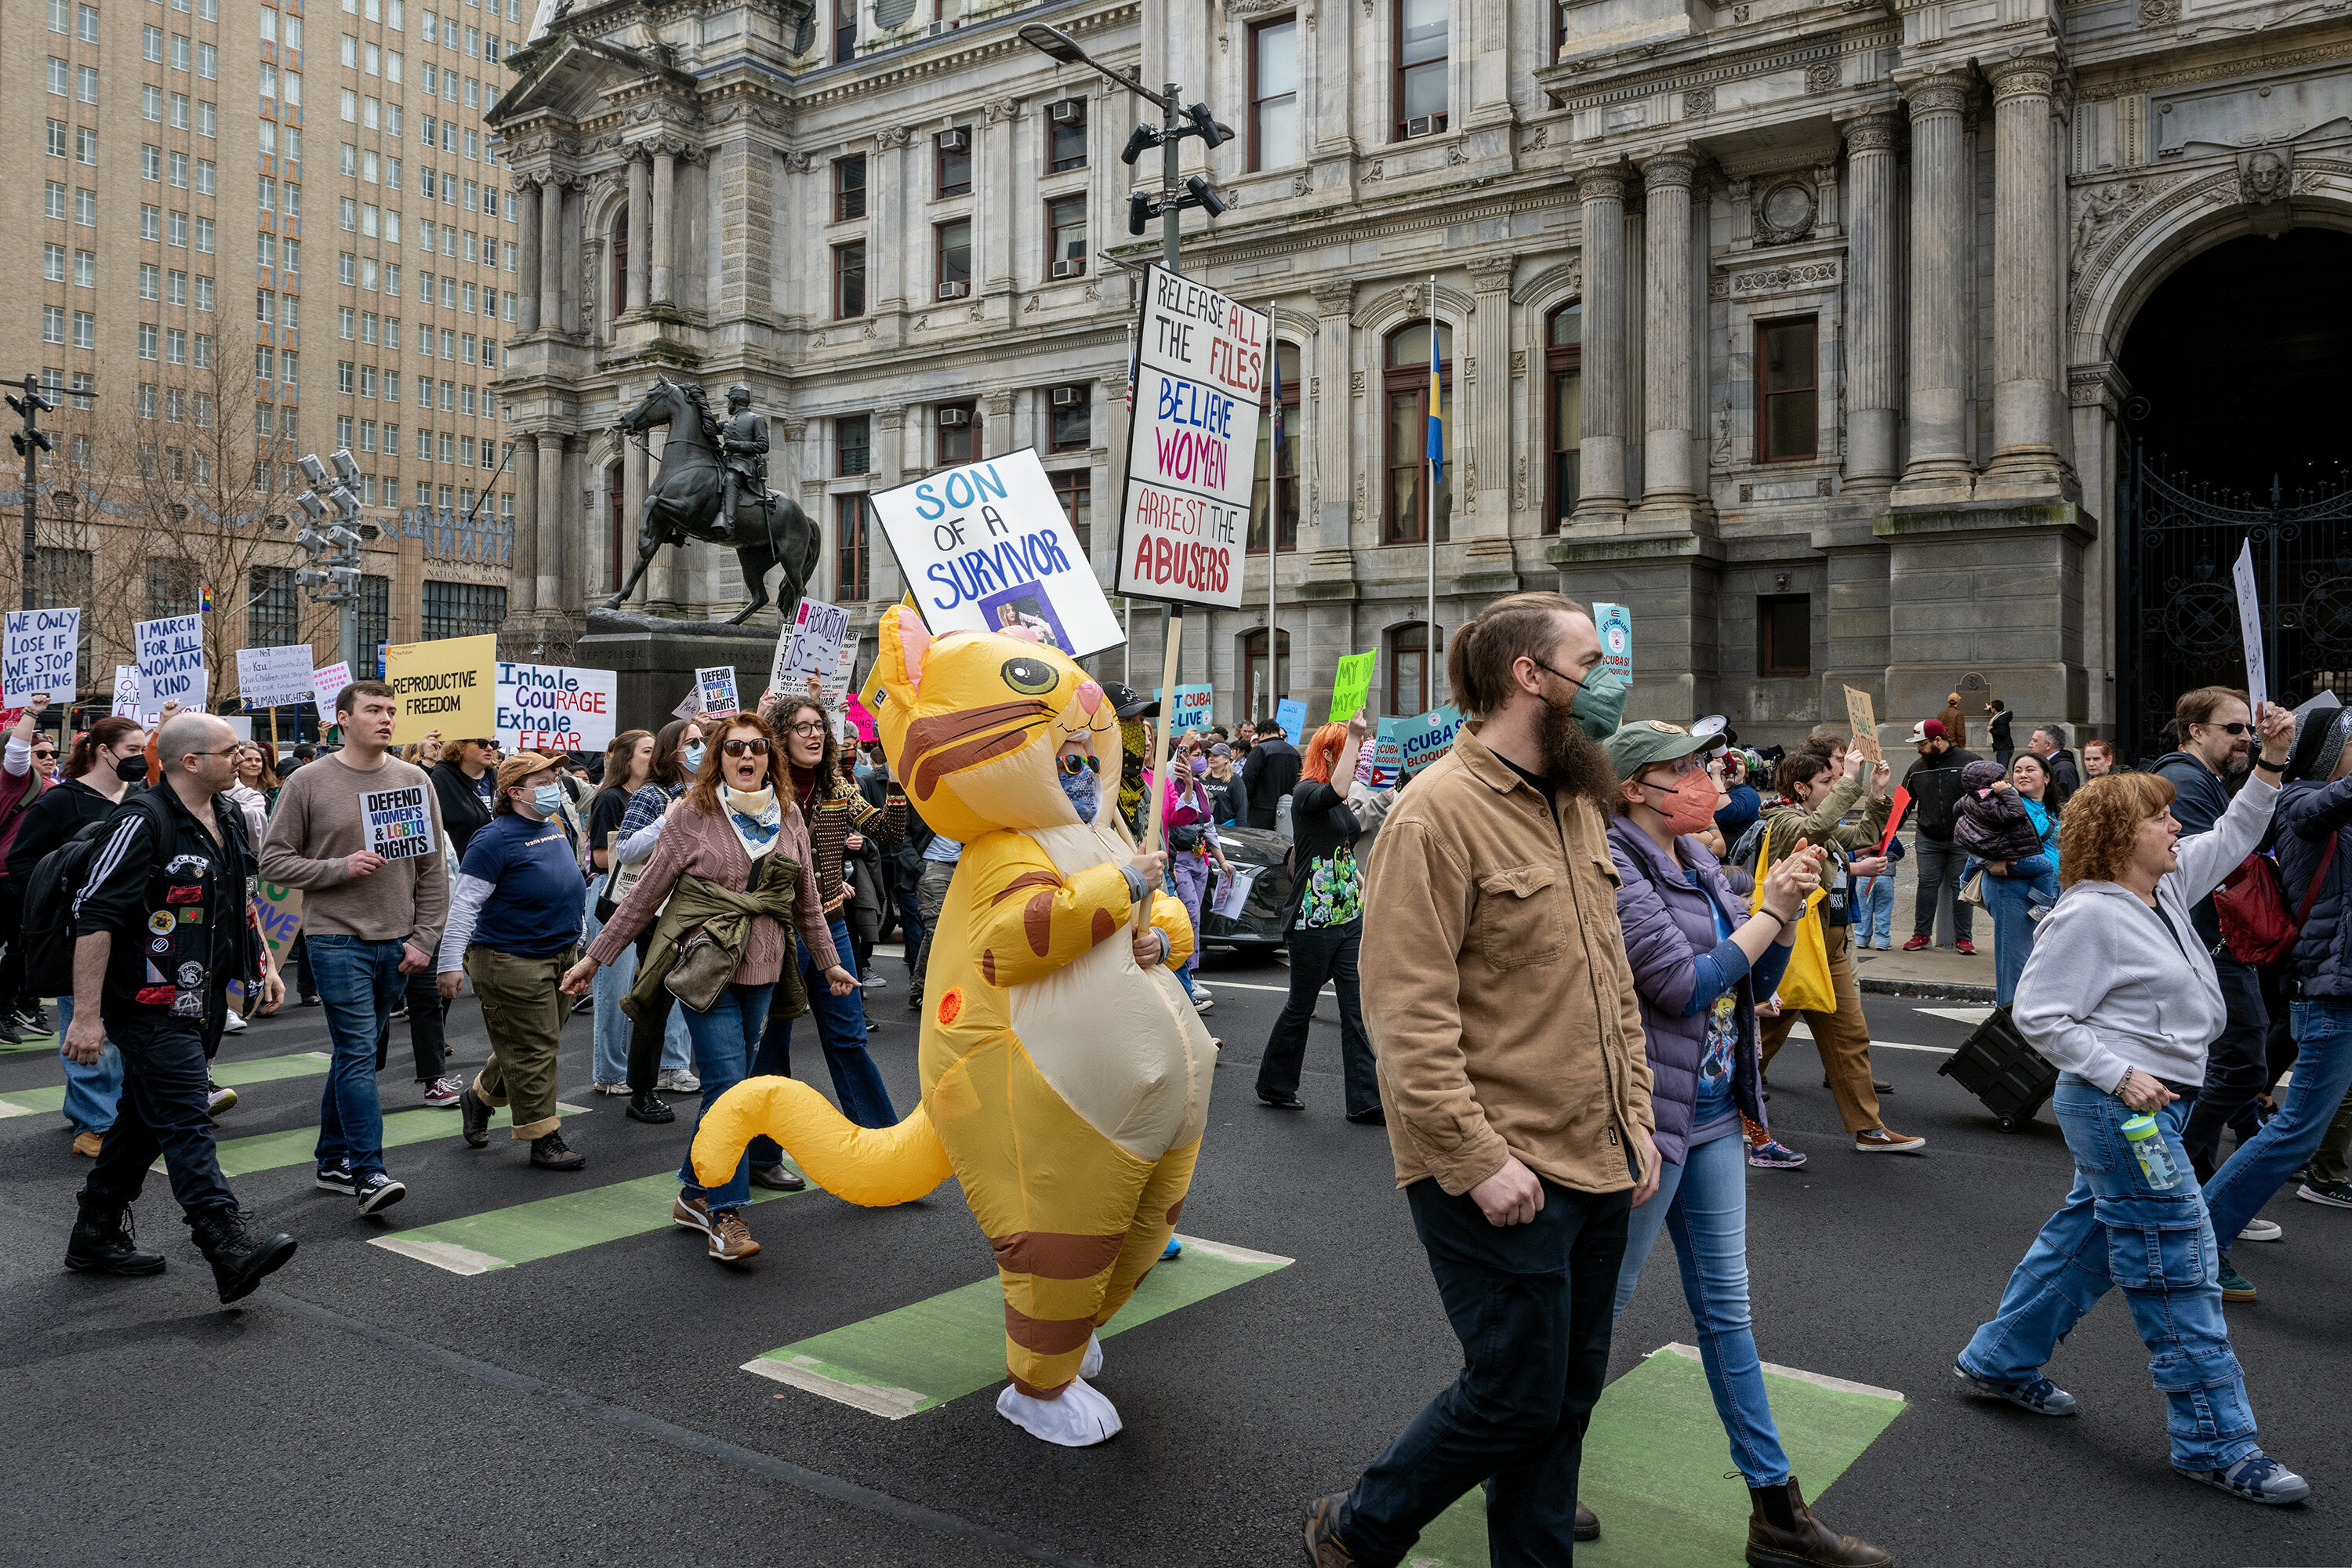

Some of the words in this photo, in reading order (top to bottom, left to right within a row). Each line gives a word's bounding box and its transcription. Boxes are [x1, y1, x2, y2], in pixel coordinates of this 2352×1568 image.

[1157, 273, 1225, 329] RELEASE
[1228, 304, 1261, 347] ALL
[1156, 314, 1194, 363] THE
[1210, 336, 1261, 393] FILES
[1158, 377, 1235, 440] BELIEVE
[1156, 426, 1228, 491] WOMEN
[915, 463, 1008, 521] SON
[1136, 488, 1207, 536] ARREST
[1211, 505, 1237, 544] THE
[934, 517, 965, 551] OF
[981, 505, 1009, 536] A
[428, 561, 463, 570] MARKET
[474, 565, 504, 574] STREET
[927, 529, 1072, 610] SURVIVOR
[1134, 533, 1229, 593] ABUSERS
[427, 569, 471, 580] NATIONAL
[7, 612, 29, 633] WE
[37, 612, 78, 633] ONLY
[140, 625, 144, 640] I
[149, 618, 195, 638] MARCH
[804, 606, 848, 647] ABORTION
[1601, 621, 1610, 633] LET
[12, 636, 45, 655] LOSE
[54, 634, 66, 650] IF
[144, 640, 169, 657] FOR
[174, 636, 198, 652] ALL
[785, 634, 805, 670] IS
[5, 657, 29, 679] WE
[34, 652, 73, 673] STOP
[138, 652, 201, 677] WOMAN
[314, 666, 344, 679] ANOTHER
[701, 668, 731, 683] DEFEND
[1337, 660, 1359, 687] MY
[5, 673, 72, 695] FIGHTING
[153, 675, 191, 699] KIND
[323, 681, 345, 690] BITCH
[394, 670, 477, 695] REPRODUCTIVE
[498, 663, 579, 692] Inhale
[703, 680, 731, 691] WOMEN'S
[252, 695, 278, 707] HUMAN
[280, 691, 307, 705] RIGHTS
[406, 695, 460, 715] FREEDOM
[706, 691, 711, 700] &
[712, 688, 734, 699] LGBTQ
[706, 697, 735, 713] RIGHTS
[1184, 691, 1210, 708] CUBA
[1330, 692, 1351, 714] MY
[496, 707, 572, 733] Exhale
[1178, 710, 1202, 728] LIVE
[520, 731, 581, 752] FEAR
[367, 787, 422, 812] DEFEND
[371, 806, 423, 826] WOMEN'S
[376, 827, 384, 841] &
[387, 819, 426, 839] LGBTQ
[374, 836, 429, 860] RIGHTS
[253, 897, 300, 942] IVE
